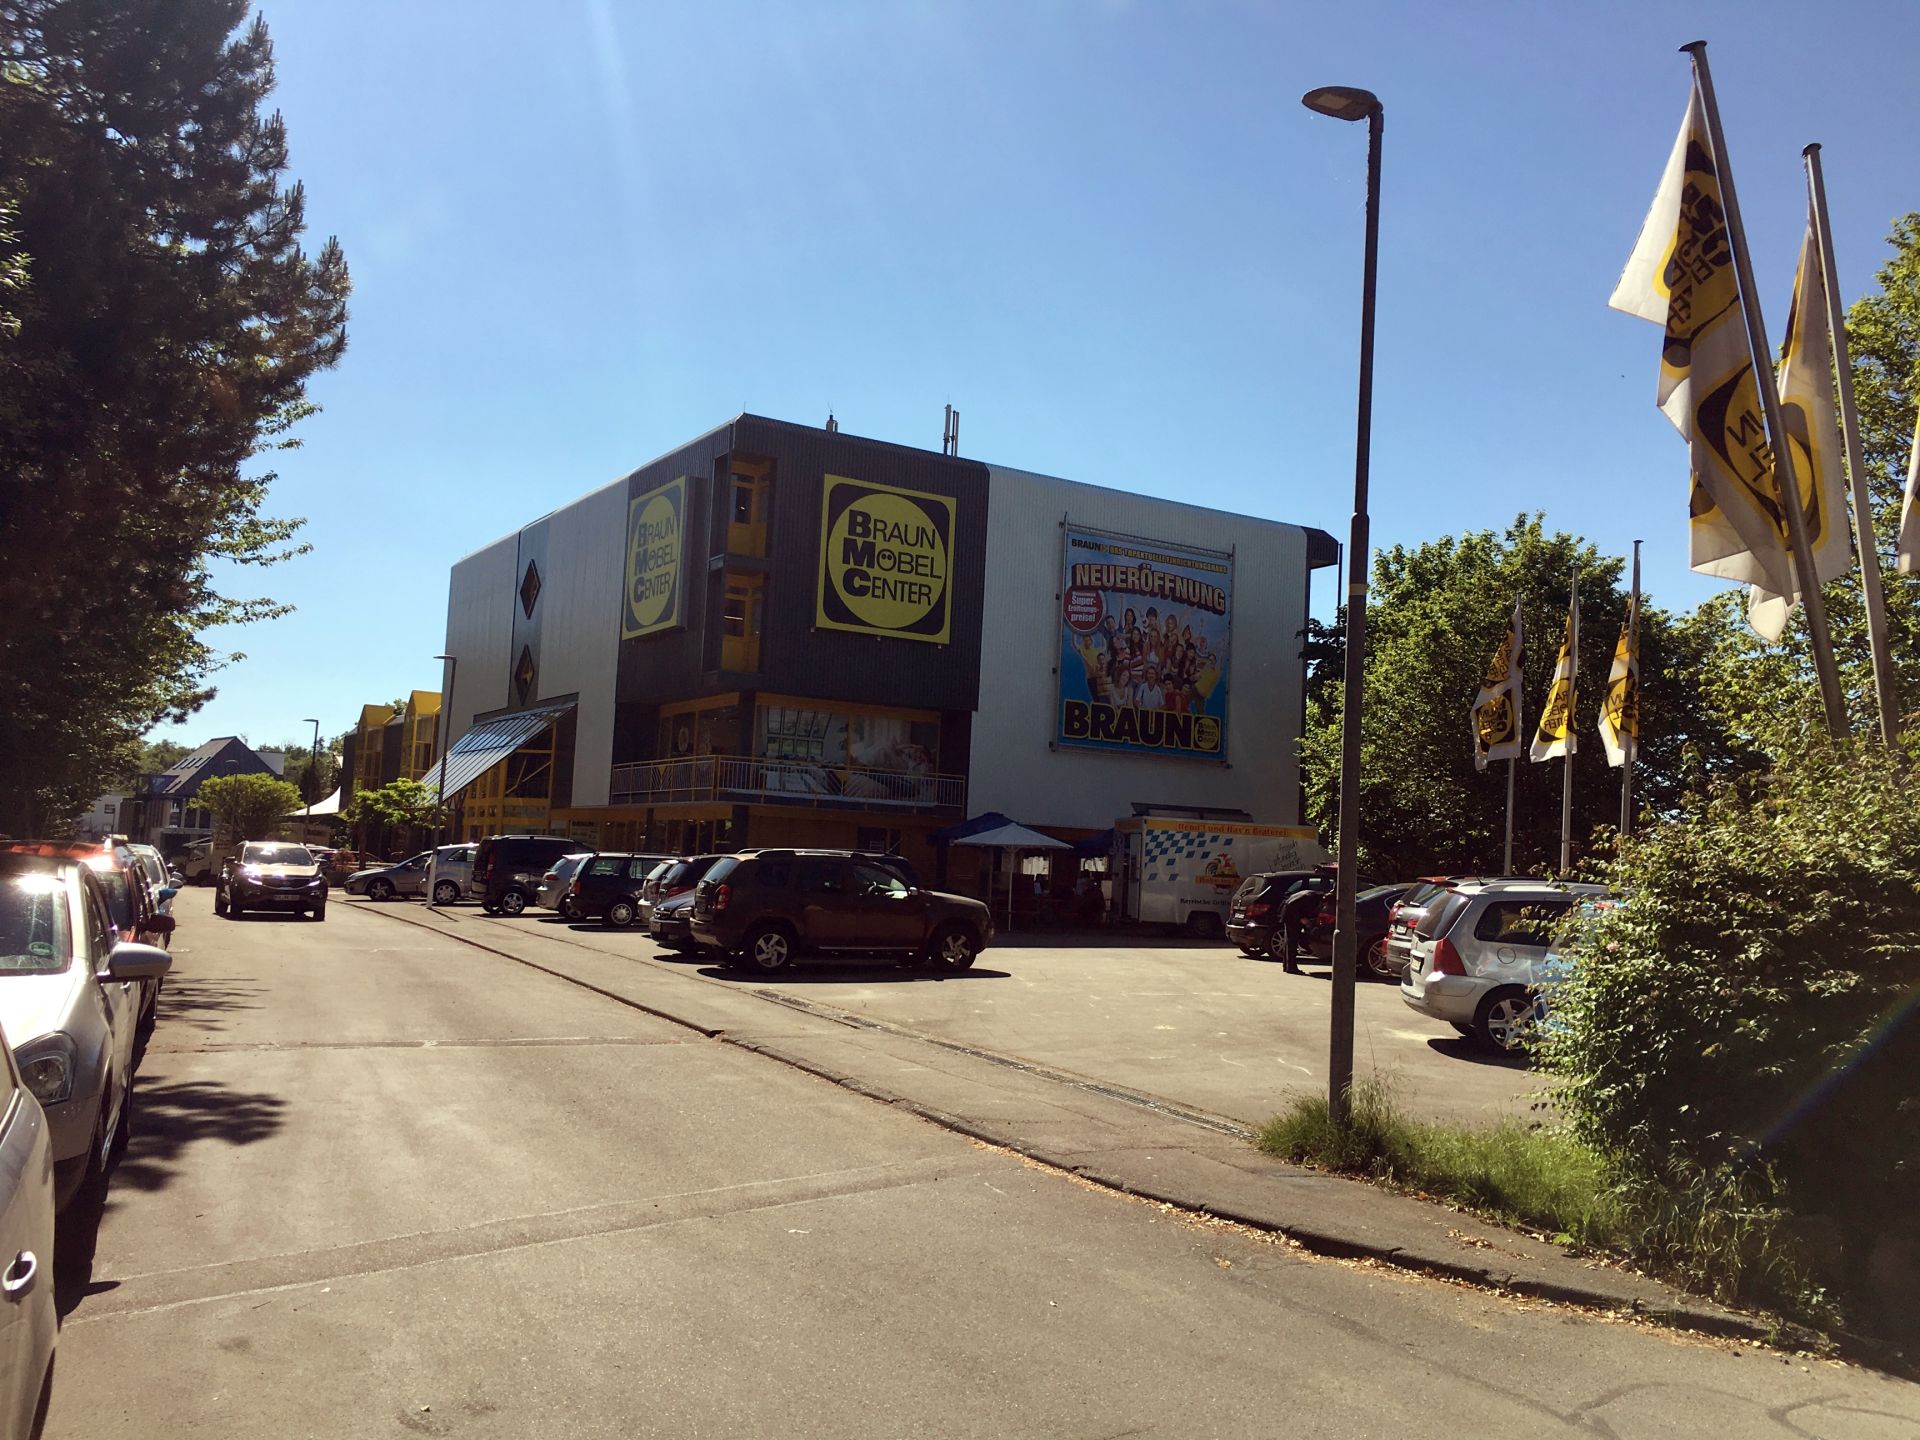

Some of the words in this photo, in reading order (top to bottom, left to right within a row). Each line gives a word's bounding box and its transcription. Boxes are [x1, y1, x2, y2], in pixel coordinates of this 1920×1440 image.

[638, 516, 675, 549] BRAUN
[847, 509, 936, 550] BRAUN
[1072, 538, 1101, 551] BRAUN
[635, 543, 677, 577] MÖBEL
[842, 537, 943, 580] MÖBEL
[634, 573, 671, 603] CENTER
[843, 567, 933, 606] CENTER
[1074, 563, 1227, 614] NEUERÖFFNUNG
[1064, 700, 1192, 749] BRAUN
